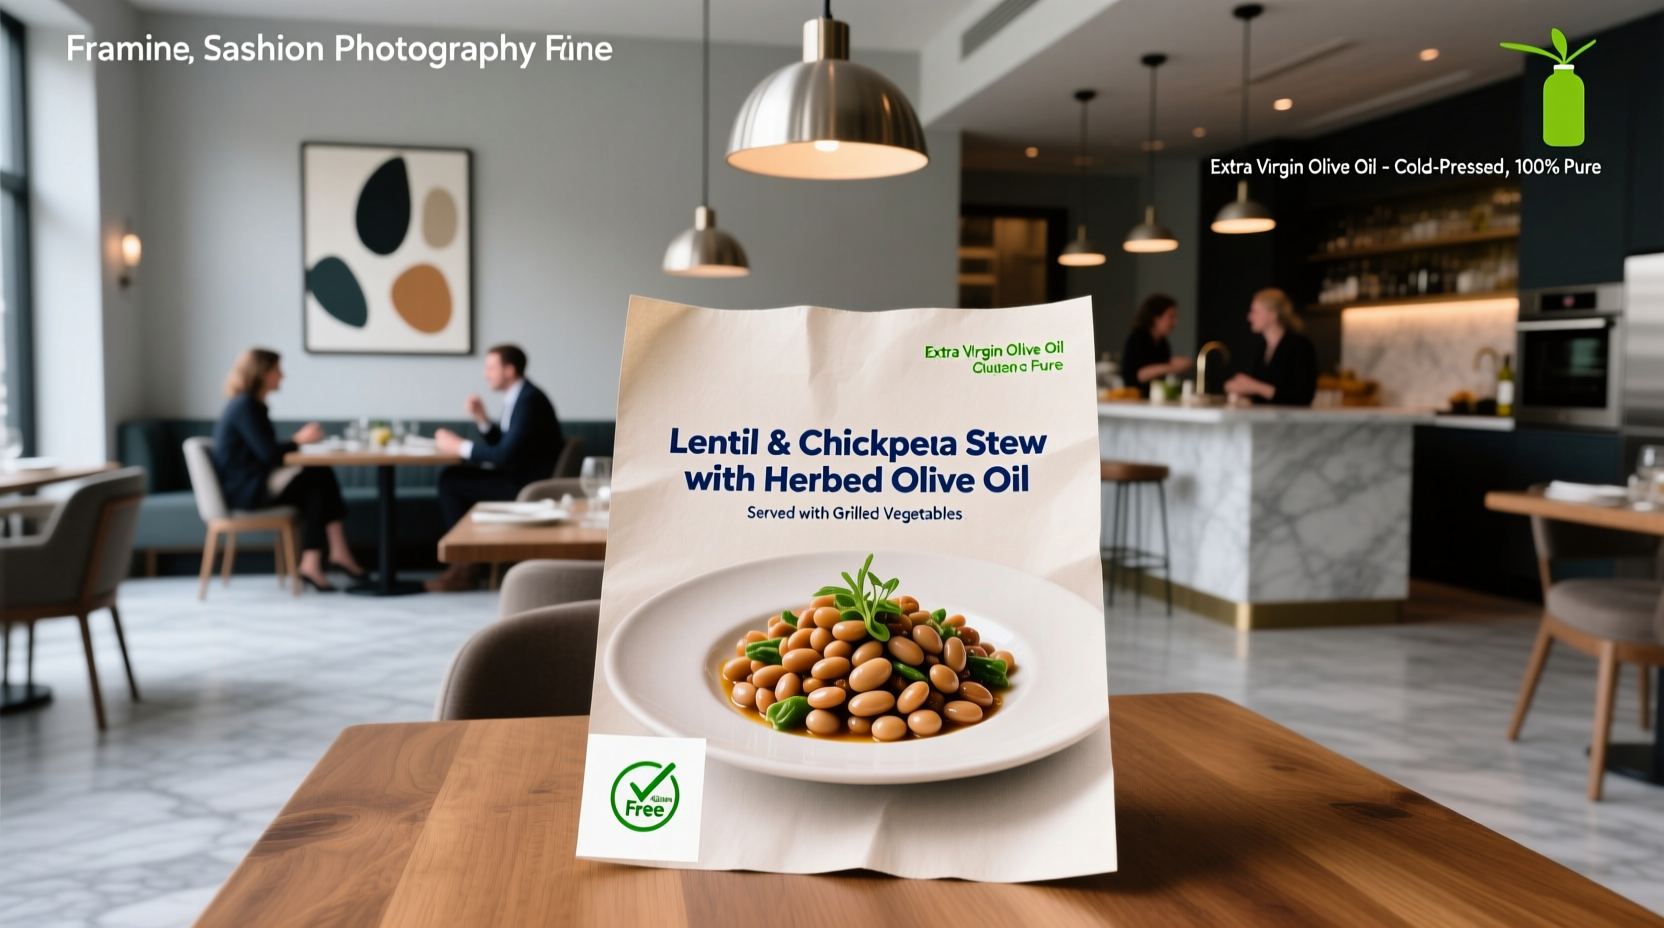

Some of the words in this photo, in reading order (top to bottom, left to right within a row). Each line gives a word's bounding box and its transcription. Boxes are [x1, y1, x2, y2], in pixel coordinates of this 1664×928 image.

[925, 345, 960, 359] Extra
[1006, 342, 1041, 357] Olive
[1045, 340, 1064, 354] Oil
[669, 427, 759, 456] Lentil
[767, 429, 791, 456] &
[965, 428, 1048, 456] Stew
[684, 464, 755, 492] with
[764, 465, 883, 493] Herbed
[891, 465, 976, 494] Olive
[983, 464, 1029, 493] Oil
[747, 505, 796, 520] Served
[799, 505, 830, 520] with
[832, 505, 880, 521] Grilled
[883, 505, 963, 525] Vegetables
[625, 800, 664, 817] Free
